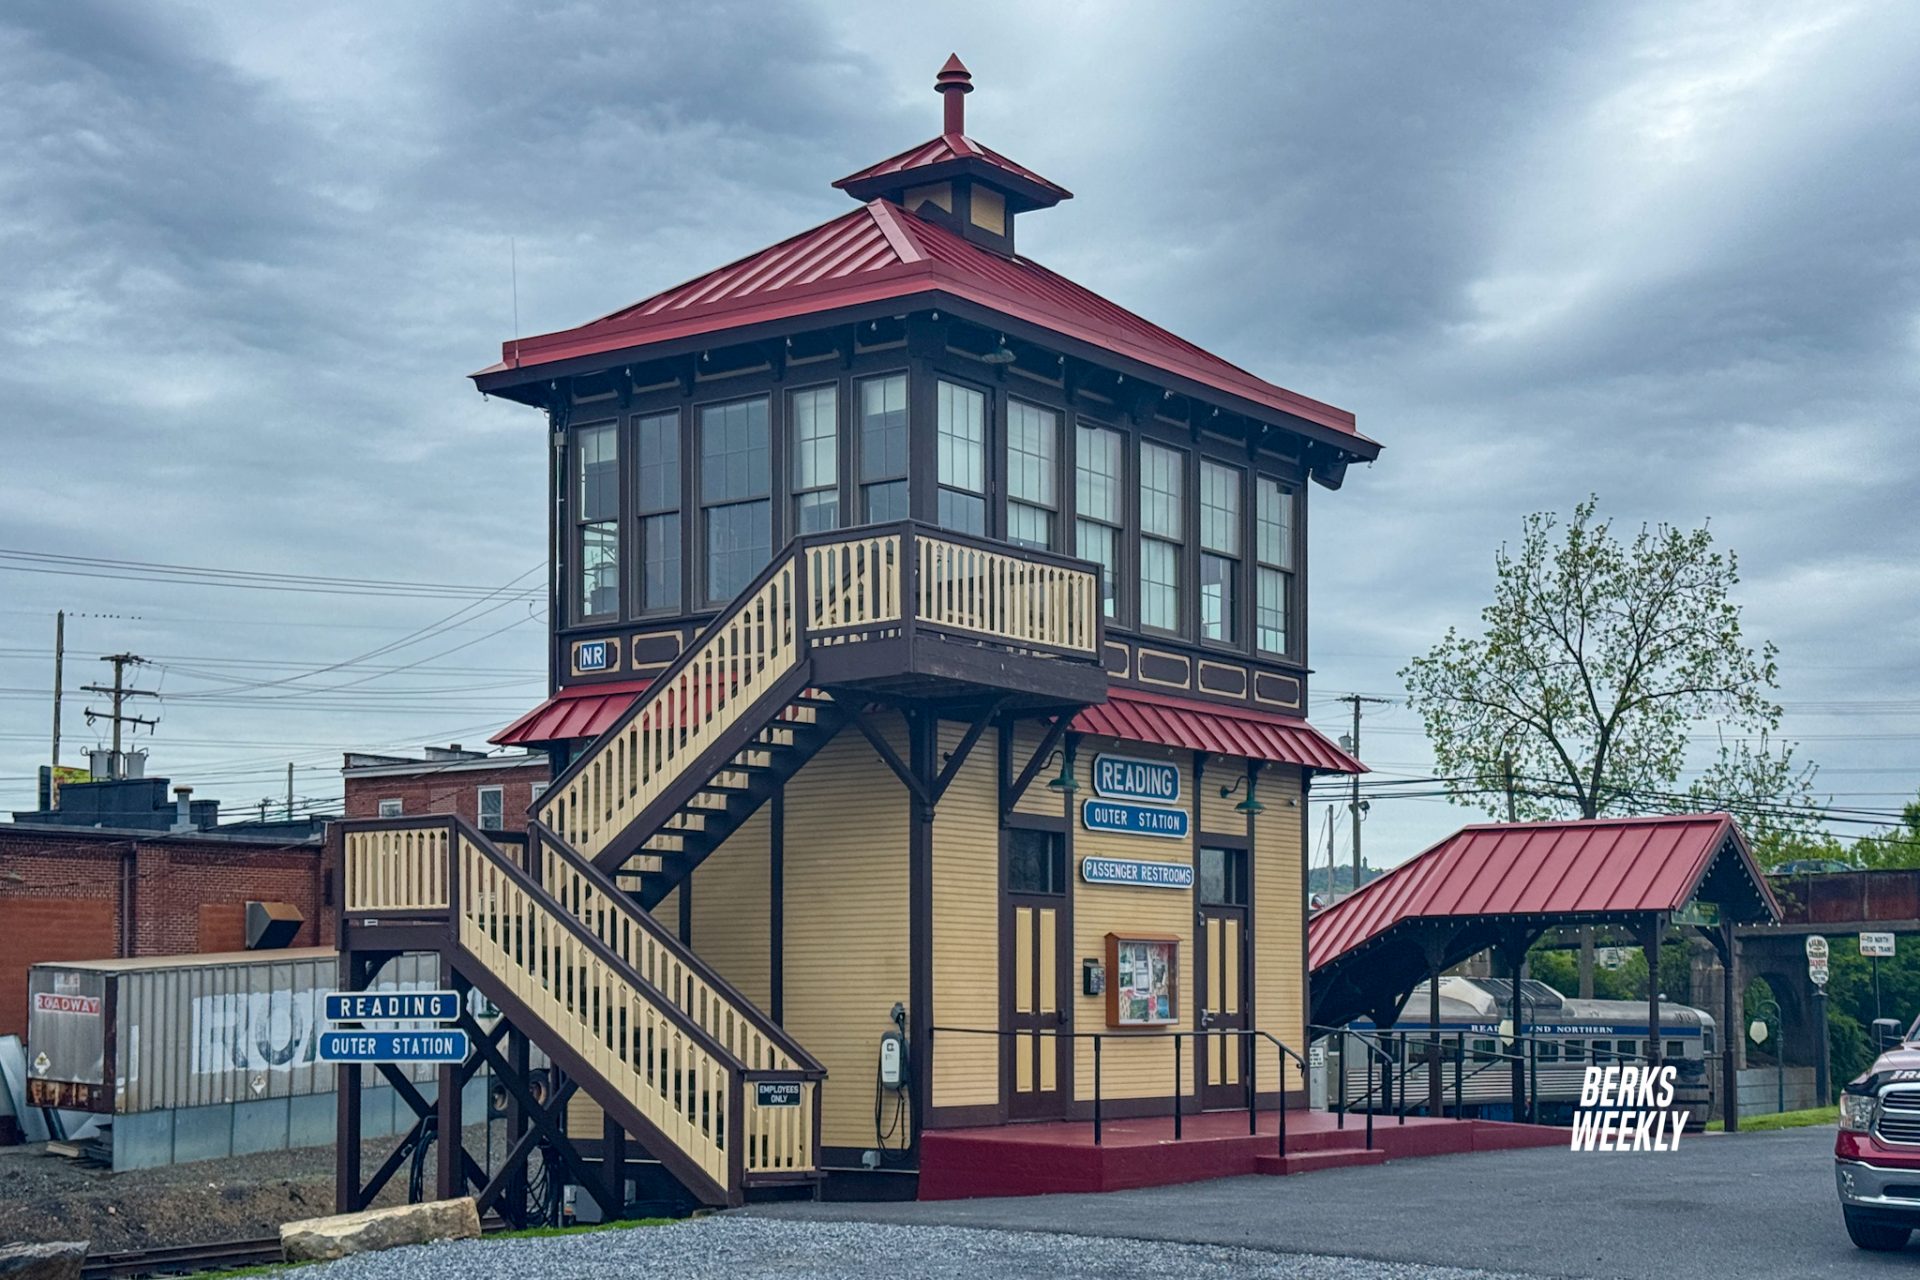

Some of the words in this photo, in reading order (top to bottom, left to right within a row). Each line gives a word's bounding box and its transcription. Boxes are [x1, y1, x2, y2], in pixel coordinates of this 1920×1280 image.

[583, 646, 603, 665] NR
[1102, 762, 1172, 796] READING
[1095, 807, 1128, 826] OUTER
[1139, 812, 1180, 830] STATION
[1086, 862, 1138, 880] PASSENGER
[1141, 866, 1191, 883] RESTROOMS
[38, 996, 99, 1012] ROADWAY
[340, 997, 441, 1017] READING
[1471, 1024, 1500, 1033] READ
[1556, 1026, 1613, 1034] NORTHERN
[331, 1038, 376, 1054] OUTER
[392, 1038, 453, 1054] STATION
[759, 1085, 799, 1094] EMPLOYEES
[770, 1095, 788, 1103] ONLY
